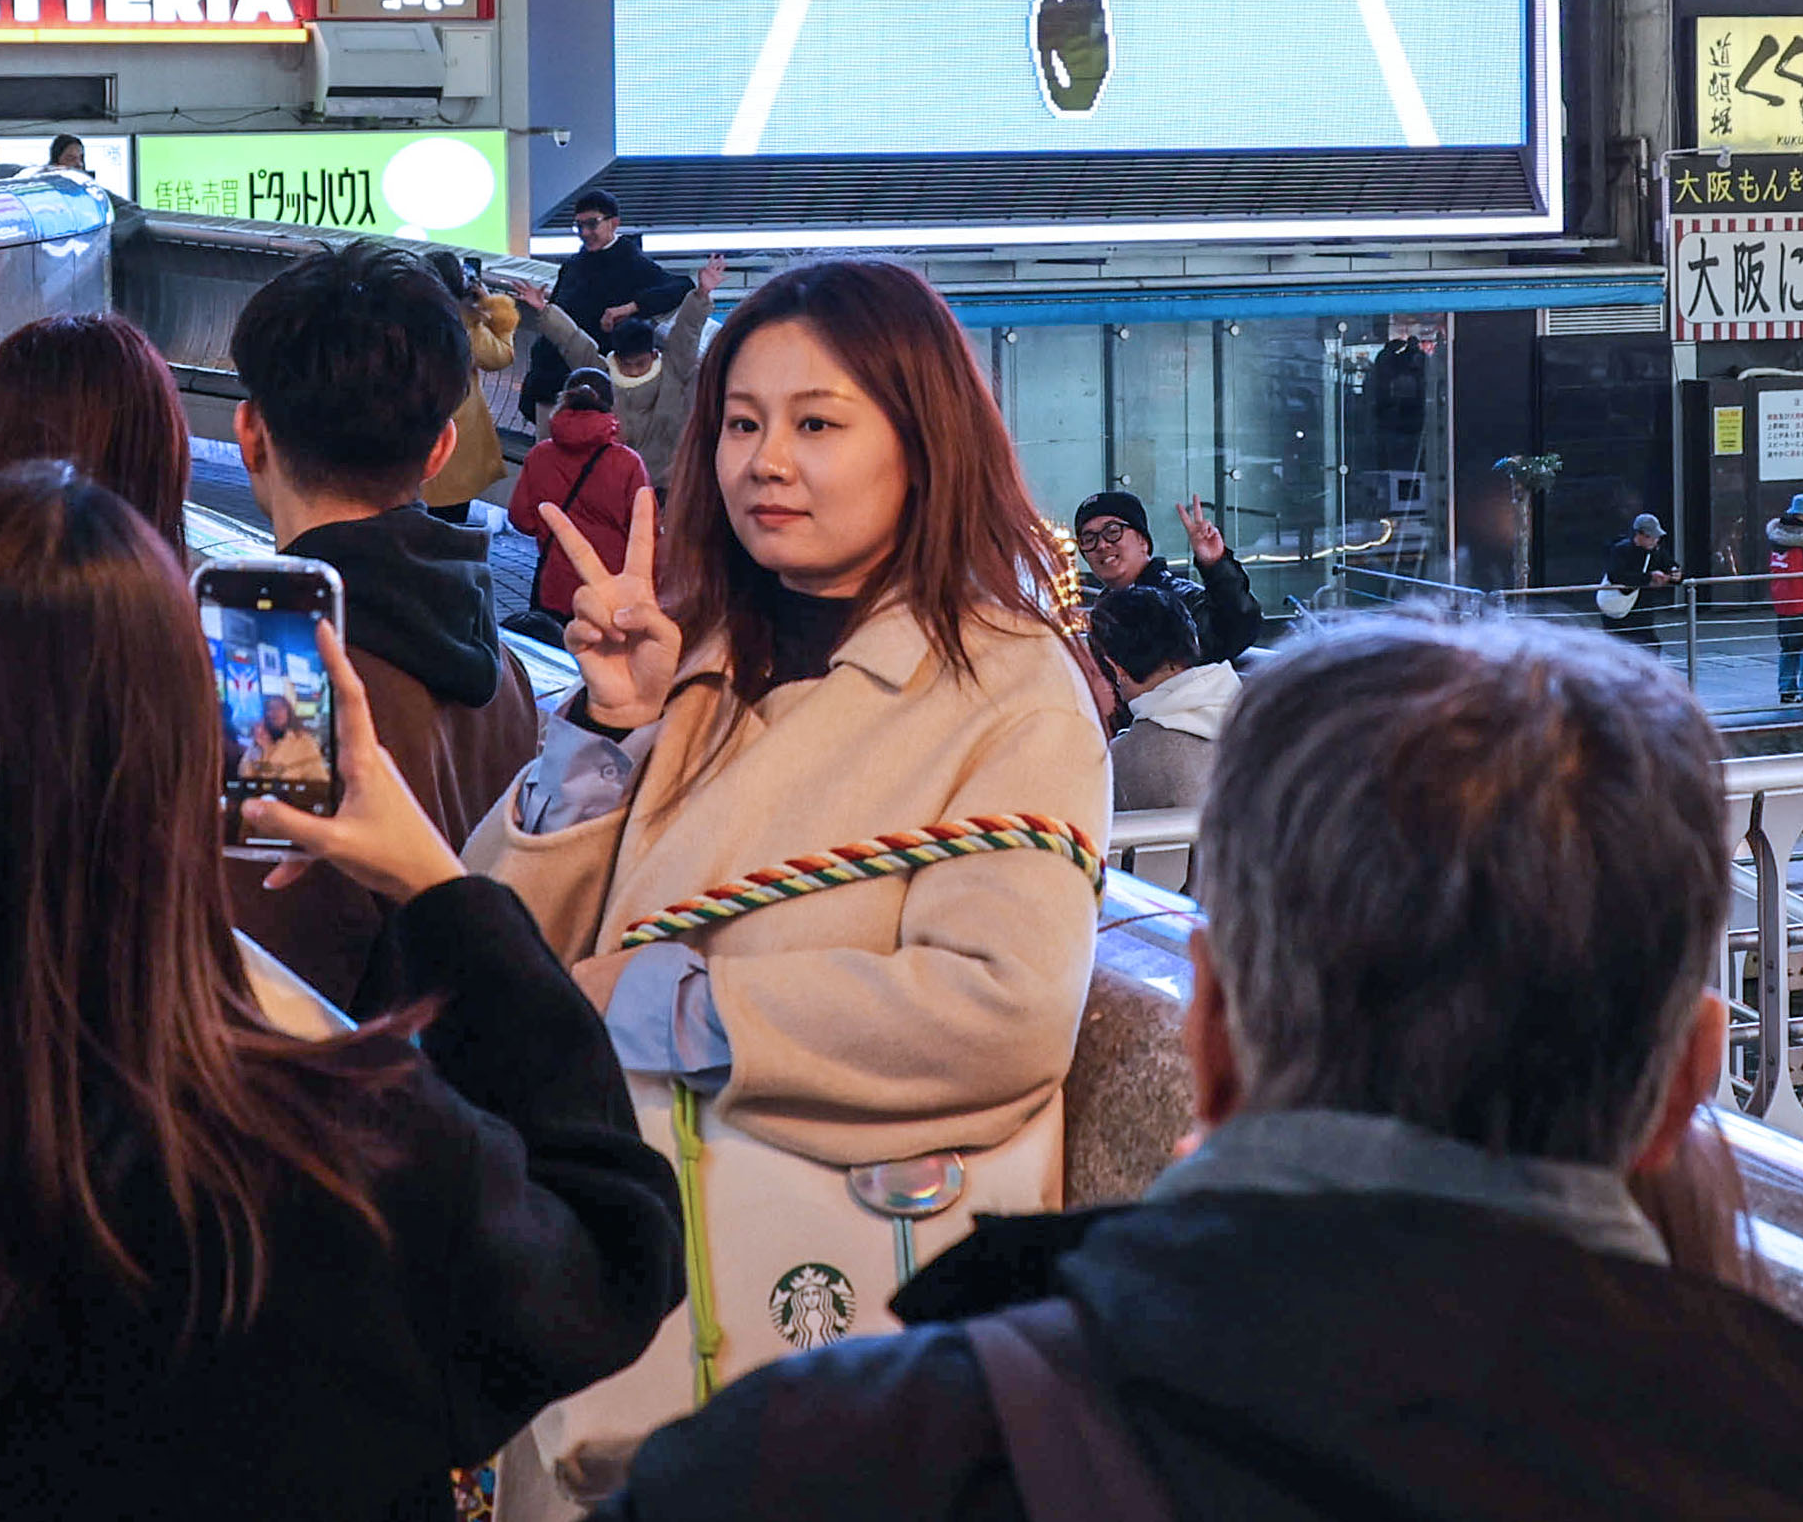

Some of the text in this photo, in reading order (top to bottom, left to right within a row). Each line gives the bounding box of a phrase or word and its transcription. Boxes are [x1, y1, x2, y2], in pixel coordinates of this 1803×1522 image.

[249, 168, 376, 228] ピタットハウス
